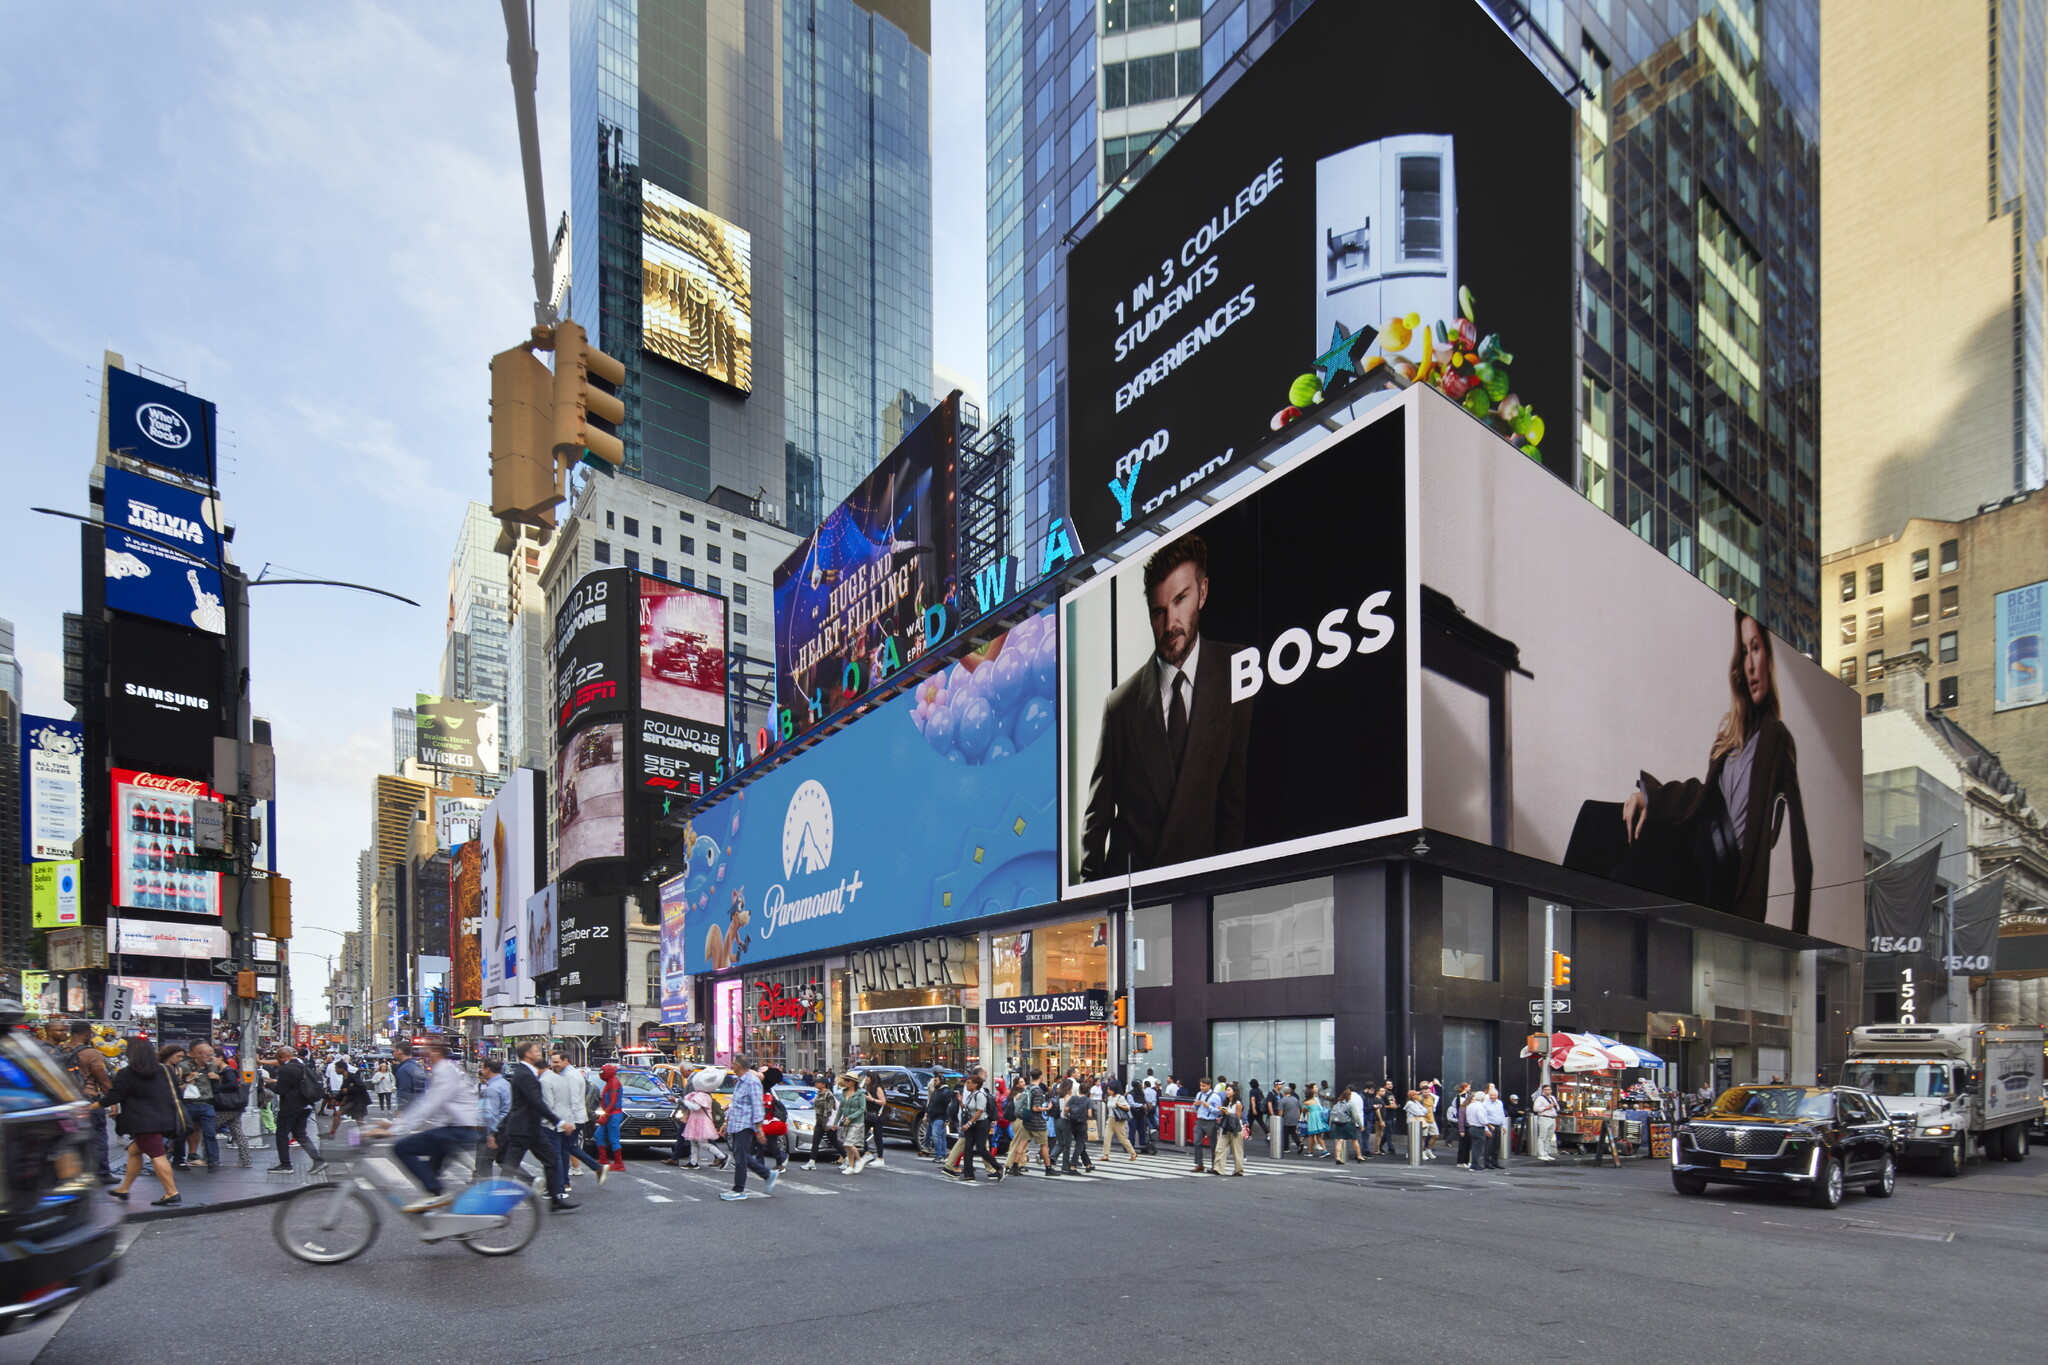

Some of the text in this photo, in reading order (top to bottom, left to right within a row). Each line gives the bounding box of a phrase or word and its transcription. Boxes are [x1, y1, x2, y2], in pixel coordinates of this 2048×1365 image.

[1114, 156, 1284, 325] 1 IN 3 COLLEGE
[660, 260, 735, 318] TSX
[1114, 256, 1219, 362] STUDENTS
[1116, 284, 1256, 414] EXPERIENCES
[148, 408, 180, 427] Who's
[148, 416, 172, 432] Your
[150, 425, 182, 445] Rock?
[128, 503, 204, 538] TRIVIA
[128, 515, 204, 544] MOMENTS
[125, 542, 142, 551] FREE
[165, 552, 188, 564] SUBWAY
[133, 540, 149, 548] PLAY
[869, 552, 892, 588] AND
[2008, 586, 2042, 608] BEST
[558, 581, 608, 639] ROUND 18
[1231, 590, 1395, 704] BOSS
[560, 656, 578, 687] SEP
[125, 682, 208, 710] SAMSUNG
[576, 680, 616, 708] ESPN
[424, 733, 472, 745] Brains. Heart.
[644, 720, 720, 745] ROUND 18
[432, 741, 464, 750] Courage.
[36, 766, 71, 775] LEADERS
[644, 754, 690, 770] SEP
[132, 772, 204, 797] Coca-Cola
[760, 870, 864, 939] Paramount+
[592, 926, 609, 938] 22
[1998, 914, 2048, 928] YCEUM
[1871, 936, 1922, 953] 1540
[850, 936, 953, 994] FOREVER
[1942, 956, 1989, 970] 1540
[1000, 996, 1087, 1014] U.S. POLO ASSN.
[1900, 968, 1916, 1024] 1540
[298, 1026, 310, 1043] tkts
[871, 1026, 924, 1044] FOREVER 21
